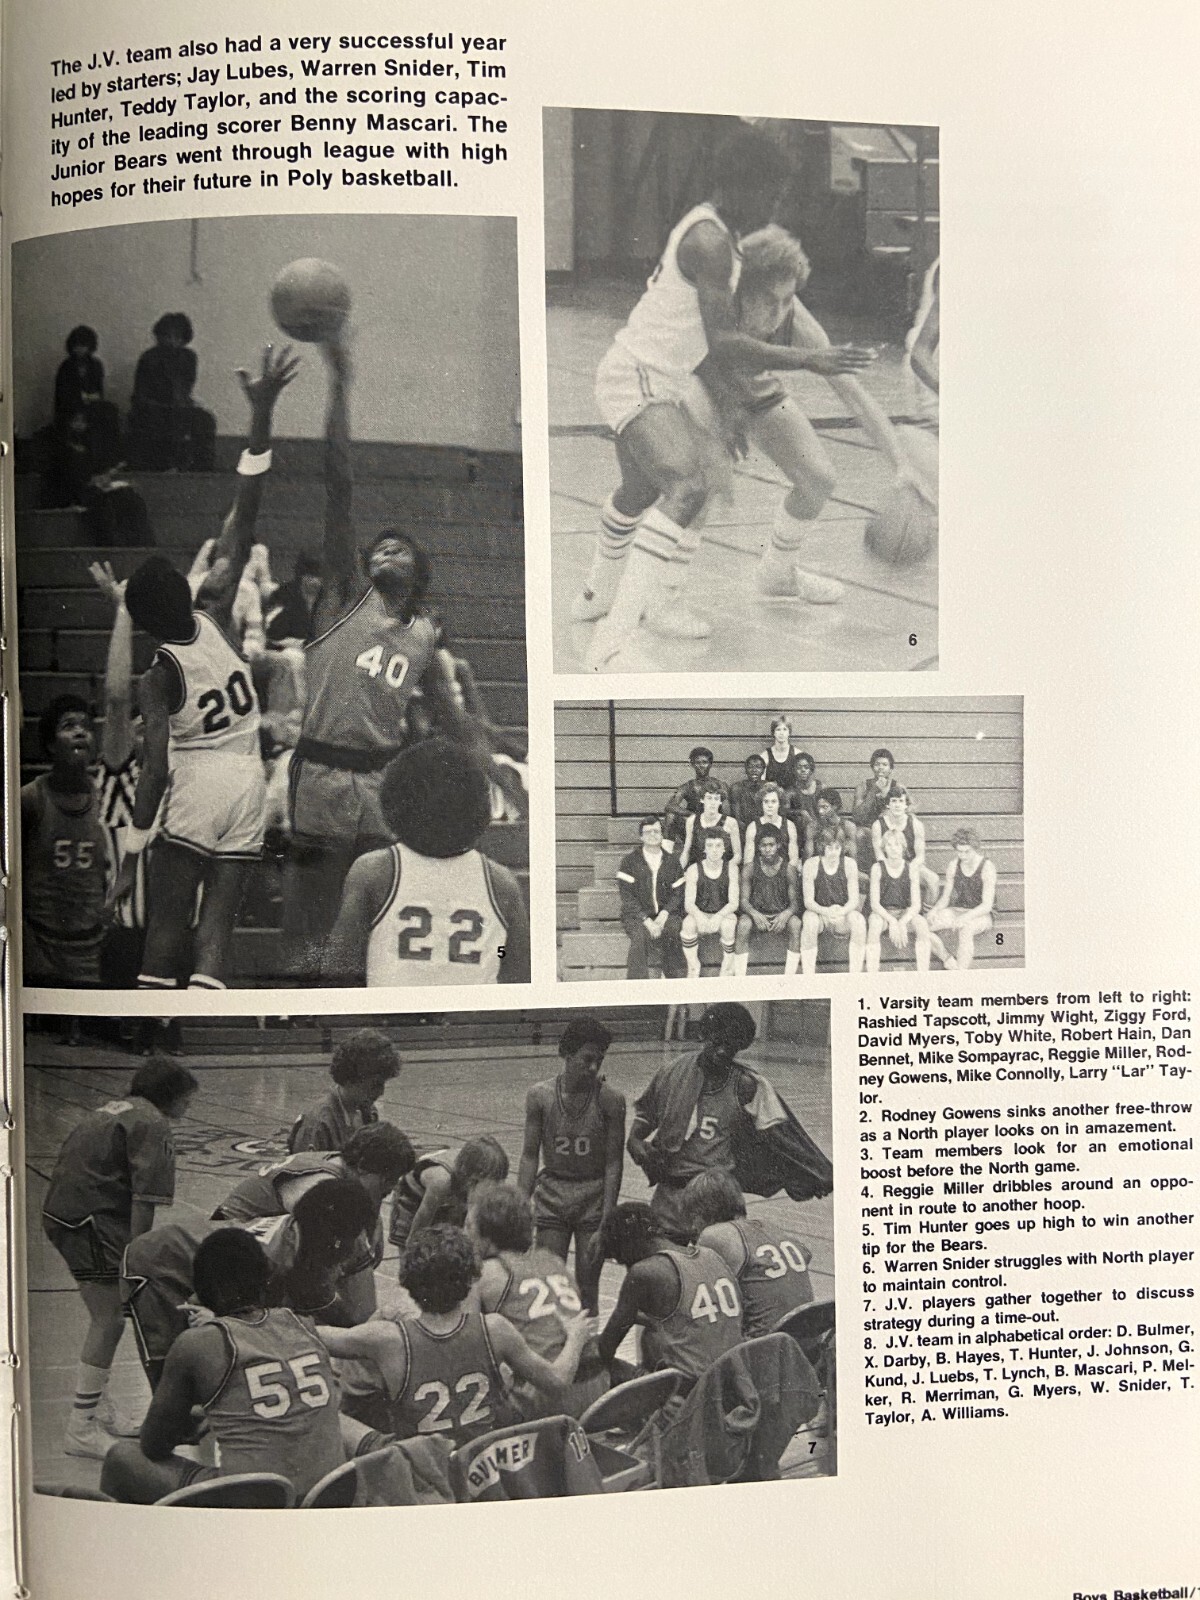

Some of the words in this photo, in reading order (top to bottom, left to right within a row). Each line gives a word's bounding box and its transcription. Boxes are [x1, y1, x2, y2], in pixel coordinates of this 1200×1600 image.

[50, 59, 83, 77] The
[87, 49, 120, 71] J.V.
[125, 46, 172, 64] team
[178, 39, 219, 58] also
[225, 34, 262, 54] had
[269, 37, 281, 51] a
[288, 36, 332, 54] very
[339, 32, 453, 50] successful
[460, 37, 507, 55] year
[51, 82, 76, 104] led
[81, 81, 102, 100] by
[106, 72, 182, 94] starters;
[186, 66, 221, 87] Jay
[226, 61, 294, 81] Lubes,
[300, 59, 377, 77] Warren
[384, 58, 460, 80] Snider,
[466, 60, 506, 79] Tim
[51, 138, 71, 158] ity
[77, 131, 95, 151] of
[101, 129, 131, 147] the
[139, 120, 208, 142] leading
[216, 119, 282, 135] scorer
[290, 114, 357, 135] Benny
[366, 113, 458, 132] Mascari.
[467, 115, 508, 134] The
[51, 187, 104, 208] hopes
[110, 181, 137, 199] for
[142, 174, 186, 195] their
[192, 172, 252, 191] future
[260, 169, 279, 188] in
[288, 168, 333, 191] Poly
[341, 168, 458, 188] basketball.
[908, 633, 918, 648] 6
[355, 645, 410, 688] 40
[197, 670, 254, 733] 20
[53, 839, 95, 869] 55
[398, 906, 485, 964] 22
[995, 933, 1005, 946] 8
[496, 946, 506, 959] 5
[857, 997, 871, 1011] 1.
[879, 996, 931, 1012] Varsity
[937, 995, 974, 1008] team
[981, 993, 1049, 1007] members
[1056, 992, 1091, 1005] from
[1098, 990, 1123, 1004] left
[1129, 990, 1144, 1003] to
[1152, 989, 1191, 1006] right:
[858, 1032, 903, 1048] David
[908, 1032, 960, 1049] Myers,
[964, 1030, 1003, 1047] Toby
[1007, 1028, 1056, 1044] White,
[1061, 1027, 1113, 1042] Robert
[1117, 1026, 1156, 1042] Hain,
[1161, 1026, 1191, 1040] Dan
[858, 1052, 914, 1067] Bennet,
[918, 1051, 954, 1065] Mike
[957, 1050, 1044, 1065] Sompayrac,
[1048, 1047, 1100, 1064] Reggie
[1104, 1045, 1152, 1061] Miller,
[1156, 1044, 1192, 1058] Rod-
[858, 1074, 885, 1089] ney
[888, 1071, 952, 1085] Gowens,
[956, 1068, 992, 1082] Mike
[995, 1066, 1065, 1083] Connolly,
[1069, 1066, 1108, 1082] Larry
[1112, 1064, 1154, 1078] “Lar”
[1158, 1063, 1192, 1080] Tay-
[859, 1091, 883, 1105] lor.
[859, 1110, 872, 1123] 2.
[881, 1108, 937, 1124] Rodney
[942, 1106, 1002, 1120] Gowens
[1006, 1104, 1046, 1118] sinks
[1052, 1103, 1110, 1117] another
[1115, 1101, 1193, 1115] free-throw
[555, 1136, 591, 1157] 20
[860, 1165, 902, 1180] boost
[906, 1164, 954, 1178] before
[959, 1162, 983, 1176] the
[988, 1160, 1029, 1175] North
[1034, 1162, 1080, 1177] game.
[860, 1185, 874, 1199] 4.
[882, 1182, 934, 1200] Reggie
[943, 1181, 985, 1195] Miller
[992, 1179, 1053, 1194] dribbles
[1061, 1176, 1114, 1191] around
[1122, 1178, 1141, 1189] an
[1150, 1177, 1194, 1191] oppo-
[862, 1223, 875, 1237] 5.
[883, 1221, 912, 1235] Tim
[919, 1220, 969, 1234] Hunter
[974, 1220, 1011, 1235] goes
[1017, 1219, 1036, 1233] up
[1042, 1215, 1075, 1232] high
[1081, 1215, 1096, 1228] to
[1103, 1213, 1129, 1227] win
[1136, 1212, 1195, 1226] another
[755, 1240, 807, 1280] 30
[861, 1242, 881, 1258] tip
[885, 1241, 907, 1254] for
[911, 1239, 935, 1253] the
[941, 1238, 988, 1252] Bears.
[862, 1261, 875, 1275] 6.
[884, 1259, 938, 1273] Warren
[942, 1256, 991, 1271] Snider
[994, 1253, 1063, 1271] struggles
[1066, 1251, 1097, 1266] with
[1102, 1250, 1144, 1264] North
[1148, 1249, 1195, 1265] player
[519, 1274, 581, 1320] 25
[690, 1277, 741, 1324] 40
[863, 1299, 876, 1312] 7.
[884, 1297, 913, 1311] J.V.
[922, 1295, 976, 1312] players
[984, 1292, 1032, 1310] gather
[1040, 1289, 1103, 1307] together
[1111, 1288, 1127, 1301] to
[1136, 1286, 1195, 1300] discuss
[863, 1317, 922, 1332] strategy
[927, 1313, 975, 1329] during
[980, 1315, 990, 1326] a
[994, 1309, 1060, 1325] time-out.
[863, 1337, 877, 1350] 8.
[885, 1334, 913, 1349] J.V.
[916, 1334, 954, 1347] team
[958, 1332, 972, 1345] in
[975, 1327, 1064, 1347] alphabetical
[1068, 1326, 1112, 1340] order:
[1116, 1324, 1132, 1338] D.
[1137, 1323, 1195, 1337] Bulmer,
[865, 1372, 908, 1388] Kund,
[911, 1371, 925, 1385] J.
[929, 1369, 979, 1384] Luebs,
[982, 1368, 997, 1381] T.
[1002, 1365, 1050, 1383] Lynch,
[1054, 1364, 1069, 1378] B.
[1074, 1361, 1138, 1377] Mascari,
[1142, 1360, 1157, 1373] P.
[1162, 1358, 1195, 1372] Mel-
[243, 1353, 331, 1420] 55
[413, 1371, 491, 1434] 22
[864, 1410, 915, 1428] Taylor,
[921, 1408, 936, 1422] A.
[942, 1406, 1009, 1420] Williams.
[808, 1442, 817, 1455] 7
